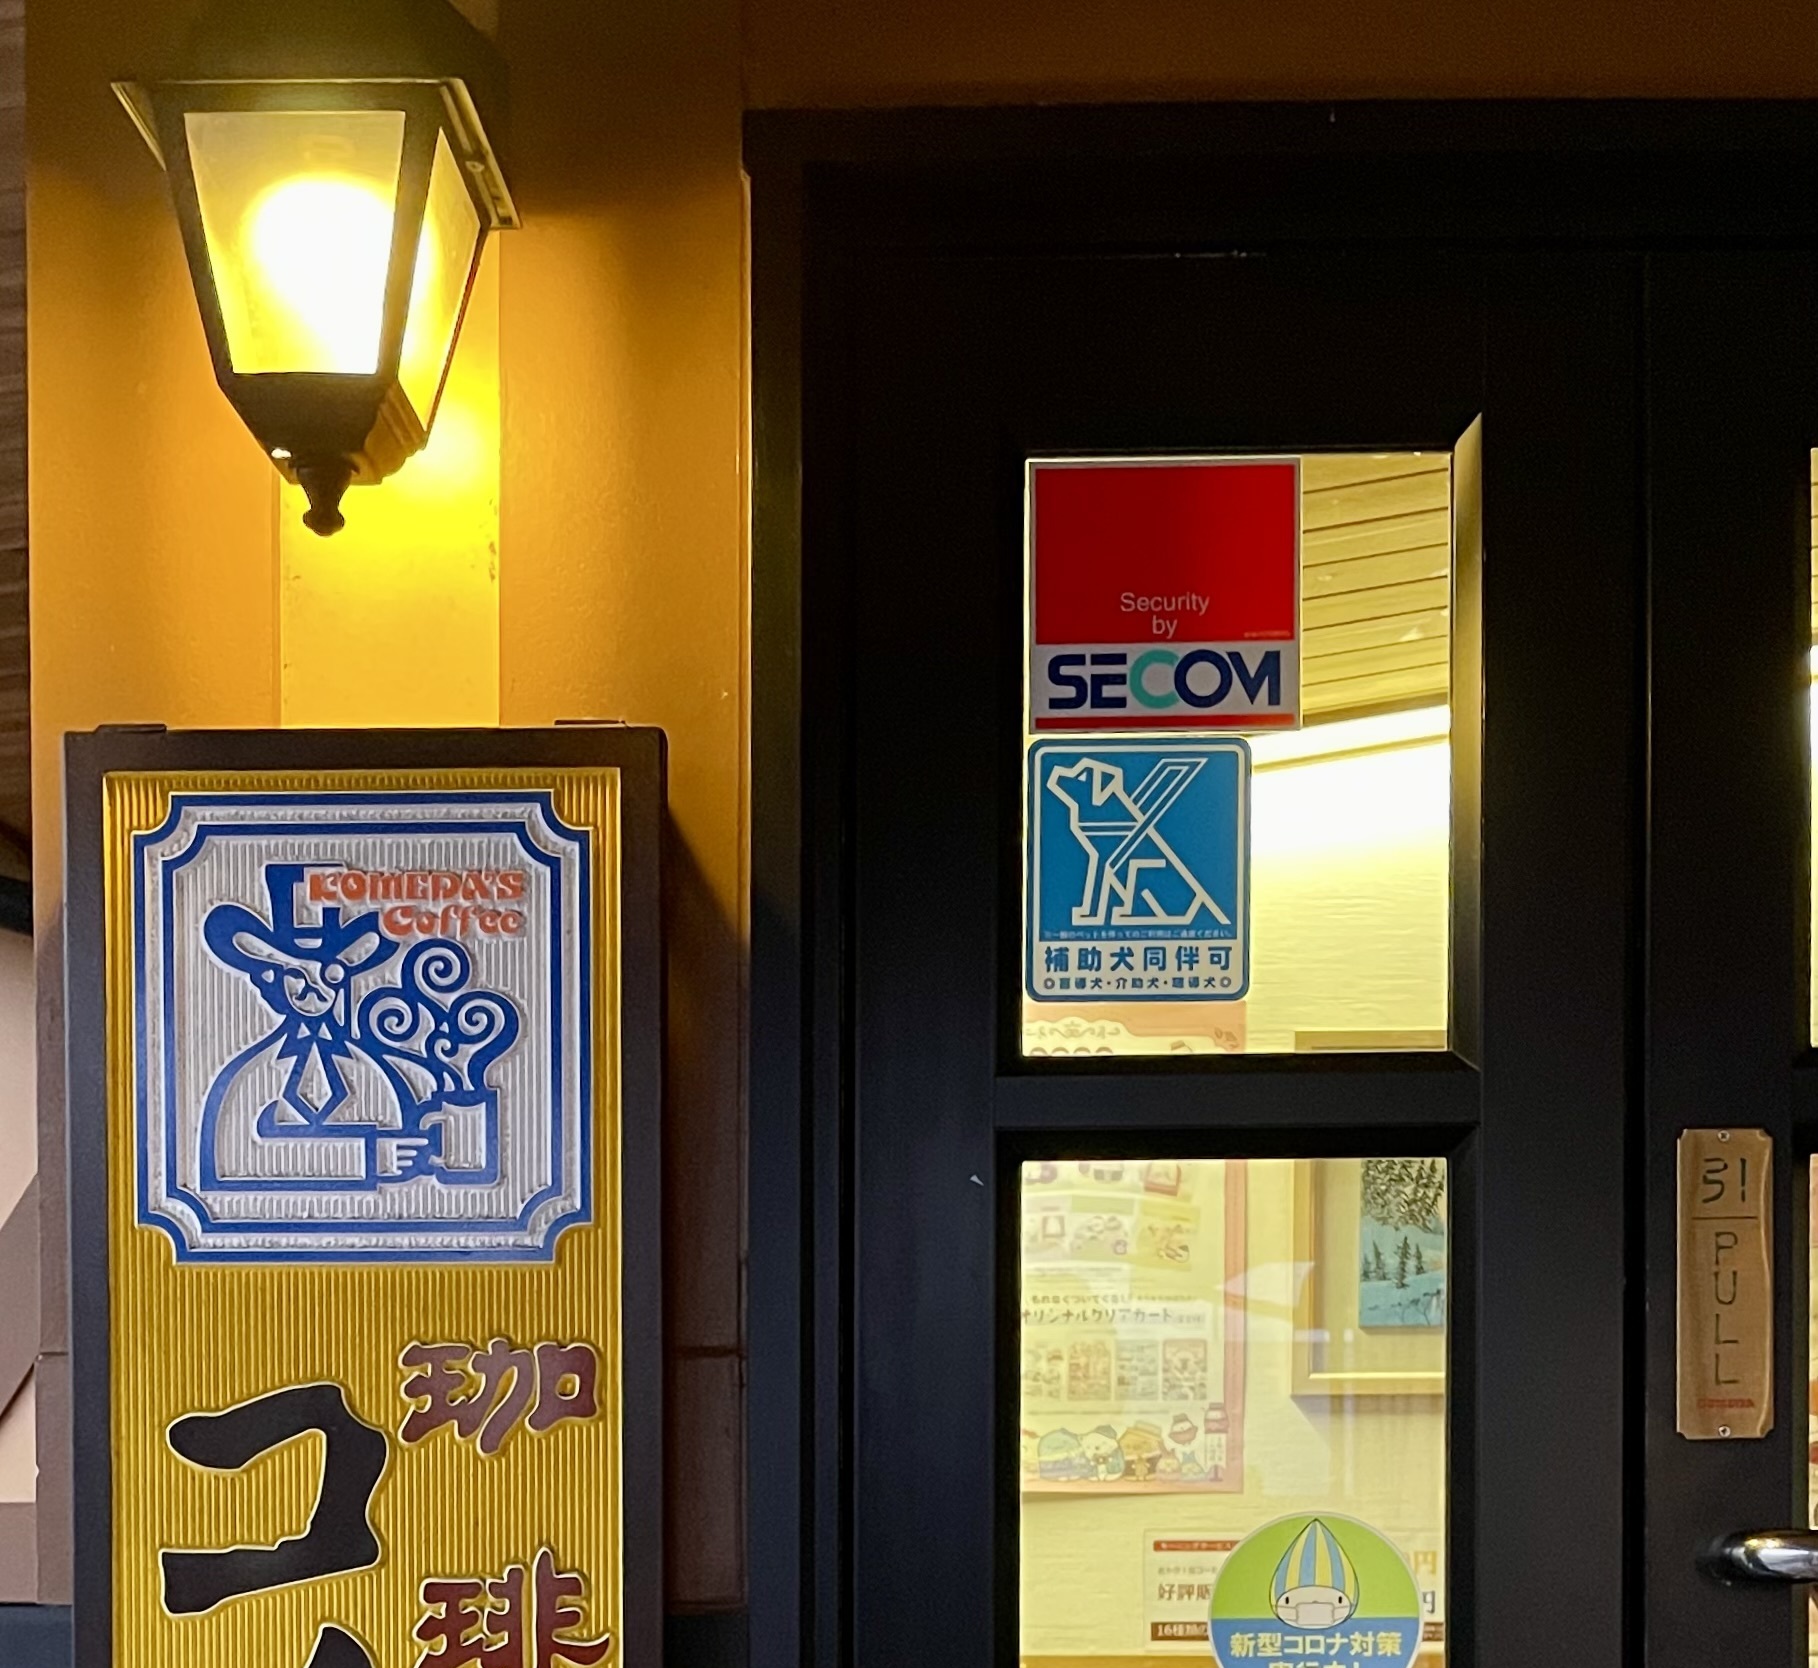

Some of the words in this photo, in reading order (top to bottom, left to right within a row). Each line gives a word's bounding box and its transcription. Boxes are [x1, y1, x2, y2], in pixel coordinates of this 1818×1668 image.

[1120, 591, 1210, 614] Security
[1151, 614, 1179, 639] by
[1047, 648, 1281, 710] SECOM
[308, 870, 526, 903] KOMEDA'S
[380, 904, 524, 939] Coffee
[1044, 946, 1233, 973] 補助犬同伴可
[1701, 1156, 1749, 1204] 引
[1713, 1231, 1740, 1386] PULL
[1230, 1632, 1402, 1658] 新型コロナ対策
